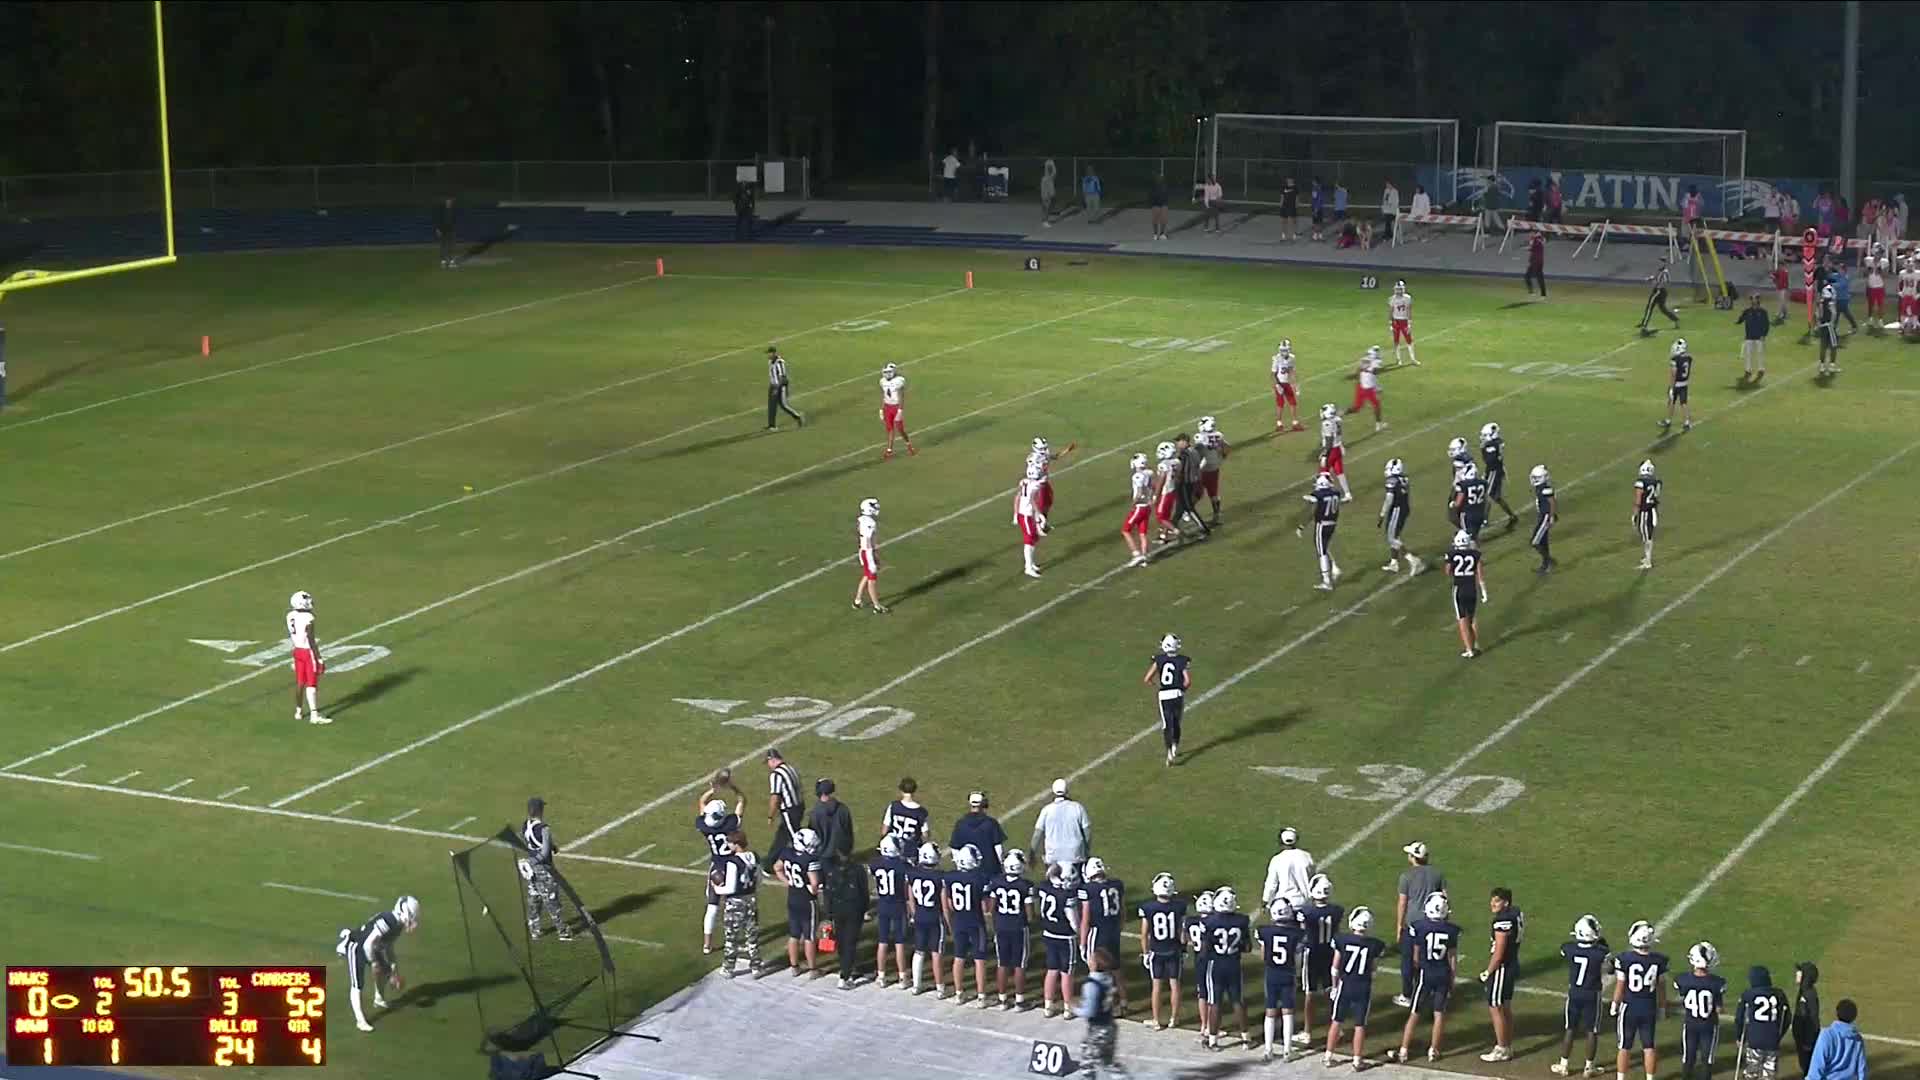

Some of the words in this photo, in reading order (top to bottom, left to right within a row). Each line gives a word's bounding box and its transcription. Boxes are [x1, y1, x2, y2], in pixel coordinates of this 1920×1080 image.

[1551, 171, 1681, 211] LATIN
[1029, 258, 1038, 270] G
[1361, 276, 1376, 289] 10
[1682, 361, 1690, 378] 3
[1467, 484, 1486, 505] 52
[1453, 554, 1475, 577] 22
[1160, 662, 1176, 686] 6
[720, 696, 916, 741] 20
[1324, 763, 1526, 814] 30
[891, 815, 918, 840] 55
[708, 833, 729, 856] 12
[874, 868, 896, 896] 31
[912, 879, 935, 908] 42
[950, 882, 972, 911] 61
[996, 888, 1021, 915] 33
[1099, 886, 1120, 917] 13
[1152, 910, 1176, 940] 81
[1317, 915, 1333, 945] 11
[1213, 927, 1241, 954] 32
[1272, 935, 1288, 966] 5
[1424, 931, 1449, 961] 15
[1345, 944, 1369, 976] 71
[1573, 955, 1589, 987] 7
[1627, 963, 1659, 993] 64
[1683, 988, 1714, 1020] 40
[1753, 994, 1778, 1022] 21
[1031, 1043, 1063, 1073] 30
